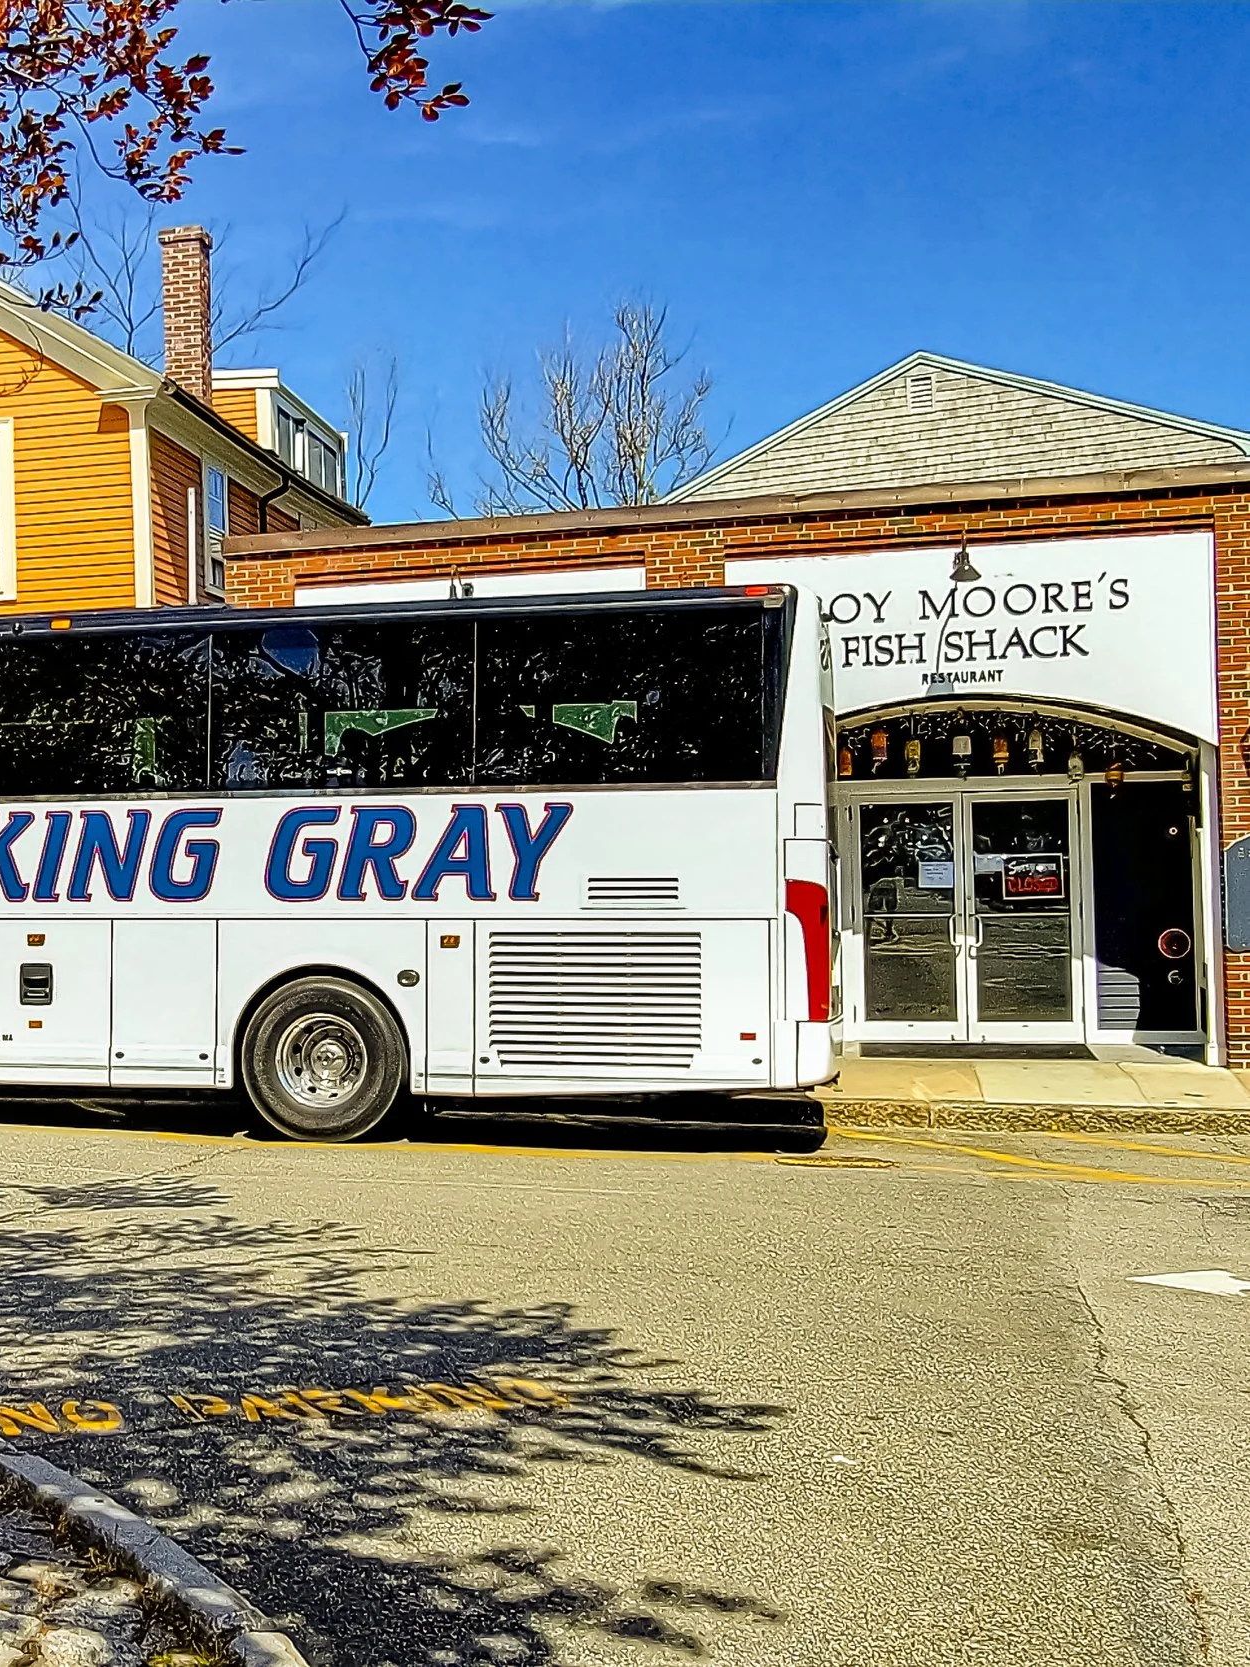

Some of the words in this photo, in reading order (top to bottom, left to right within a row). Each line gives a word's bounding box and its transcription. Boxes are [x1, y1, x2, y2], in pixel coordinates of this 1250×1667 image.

[816, 590, 892, 625] OY
[918, 571, 1129, 620] MOORE'S
[841, 632, 927, 668] FISH
[944, 624, 1089, 662] SHACK
[921, 670, 1004, 685] RESTAURANT
[264, 802, 573, 903] GRAY
